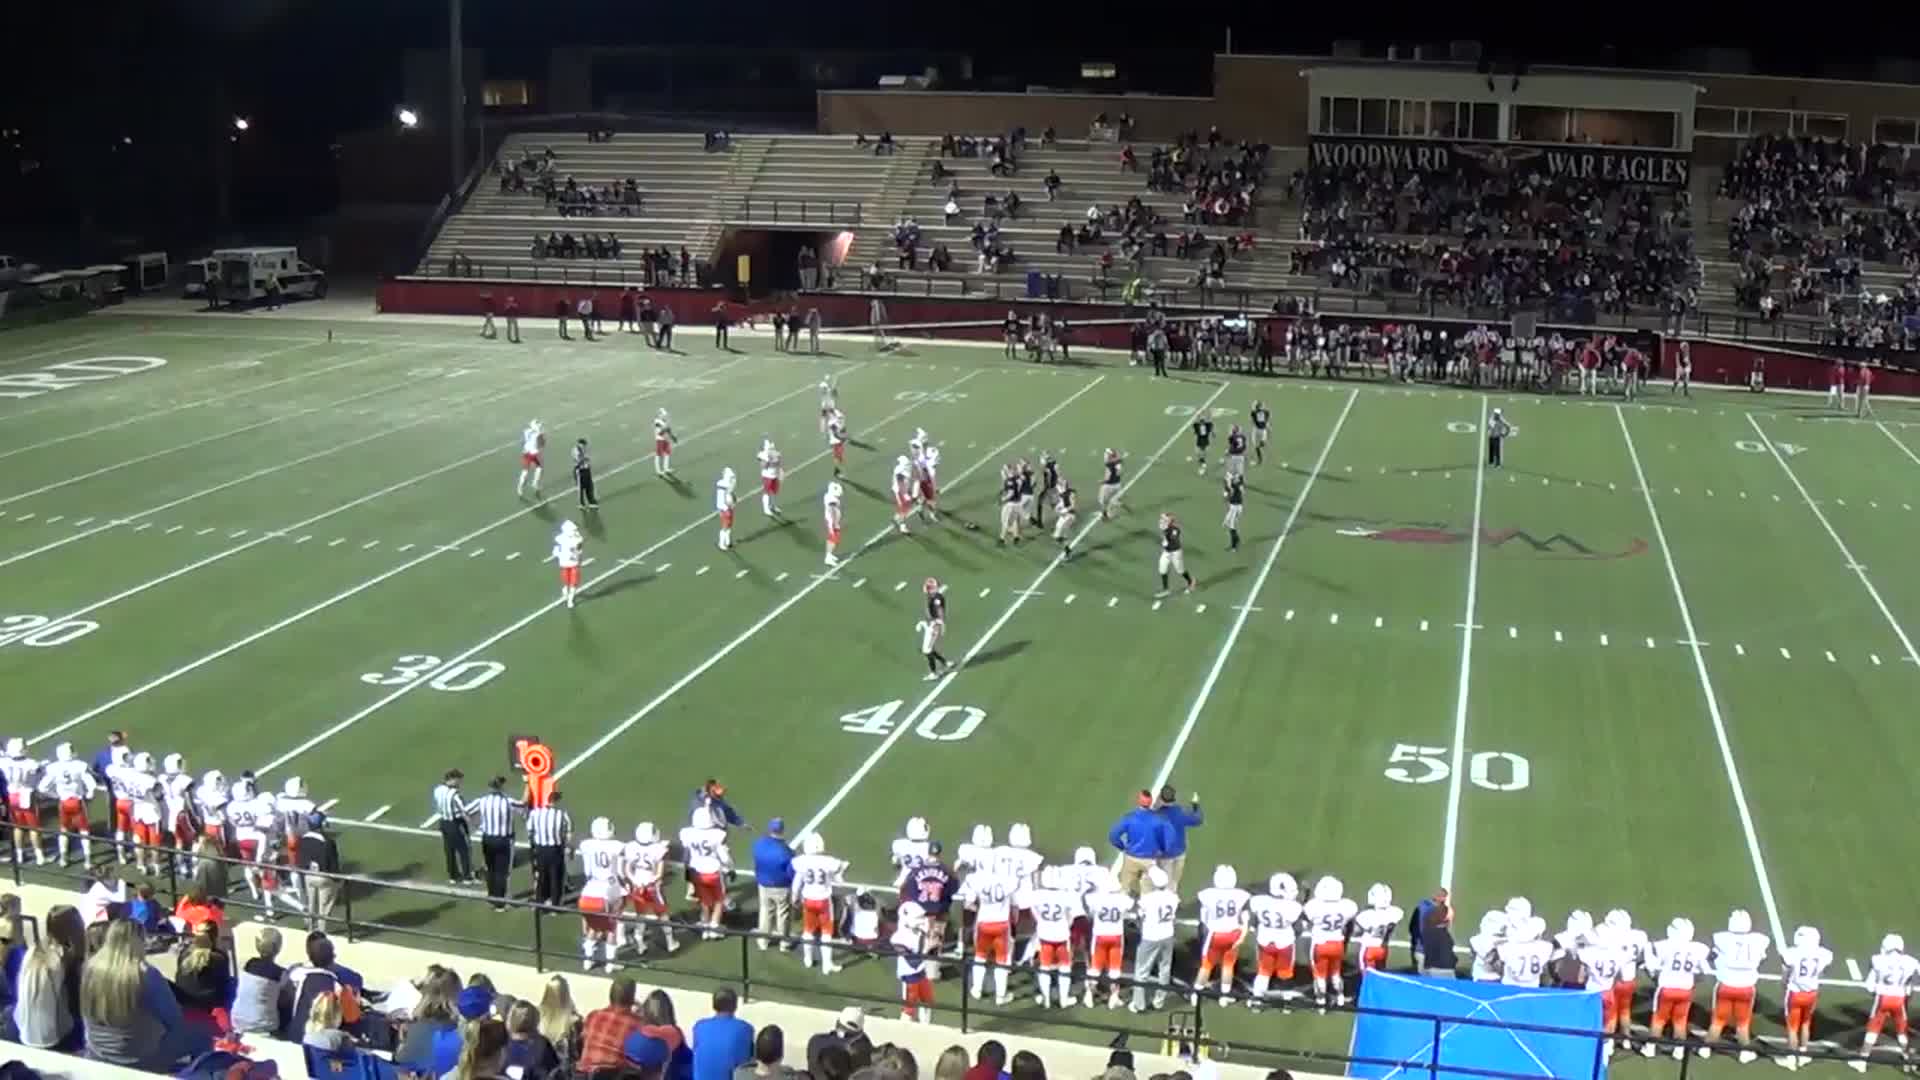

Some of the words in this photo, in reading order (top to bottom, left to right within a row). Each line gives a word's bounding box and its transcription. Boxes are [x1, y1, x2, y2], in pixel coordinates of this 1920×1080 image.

[1312, 143, 1448, 171] WOODWARD
[1547, 152, 1596, 178] WAR
[1602, 155, 1689, 184] EAGLES
[360, 654, 506, 692] 30
[839, 700, 987, 741] 40
[1383, 743, 1531, 791] 50
[594, 852, 609, 869] 10
[804, 868, 826, 885] 33
[982, 883, 1005, 904] 40
[1041, 903, 1062, 921] 22
[1098, 907, 1120, 923] 20
[1158, 905, 1173, 924] 12
[1215, 901, 1237, 918] 68
[1261, 911, 1283, 929] 53
[1323, 912, 1344, 931] 52
[1518, 955, 1541, 976] 78
[1595, 959, 1617, 978] 43
[1671, 952, 1693, 972] 66
